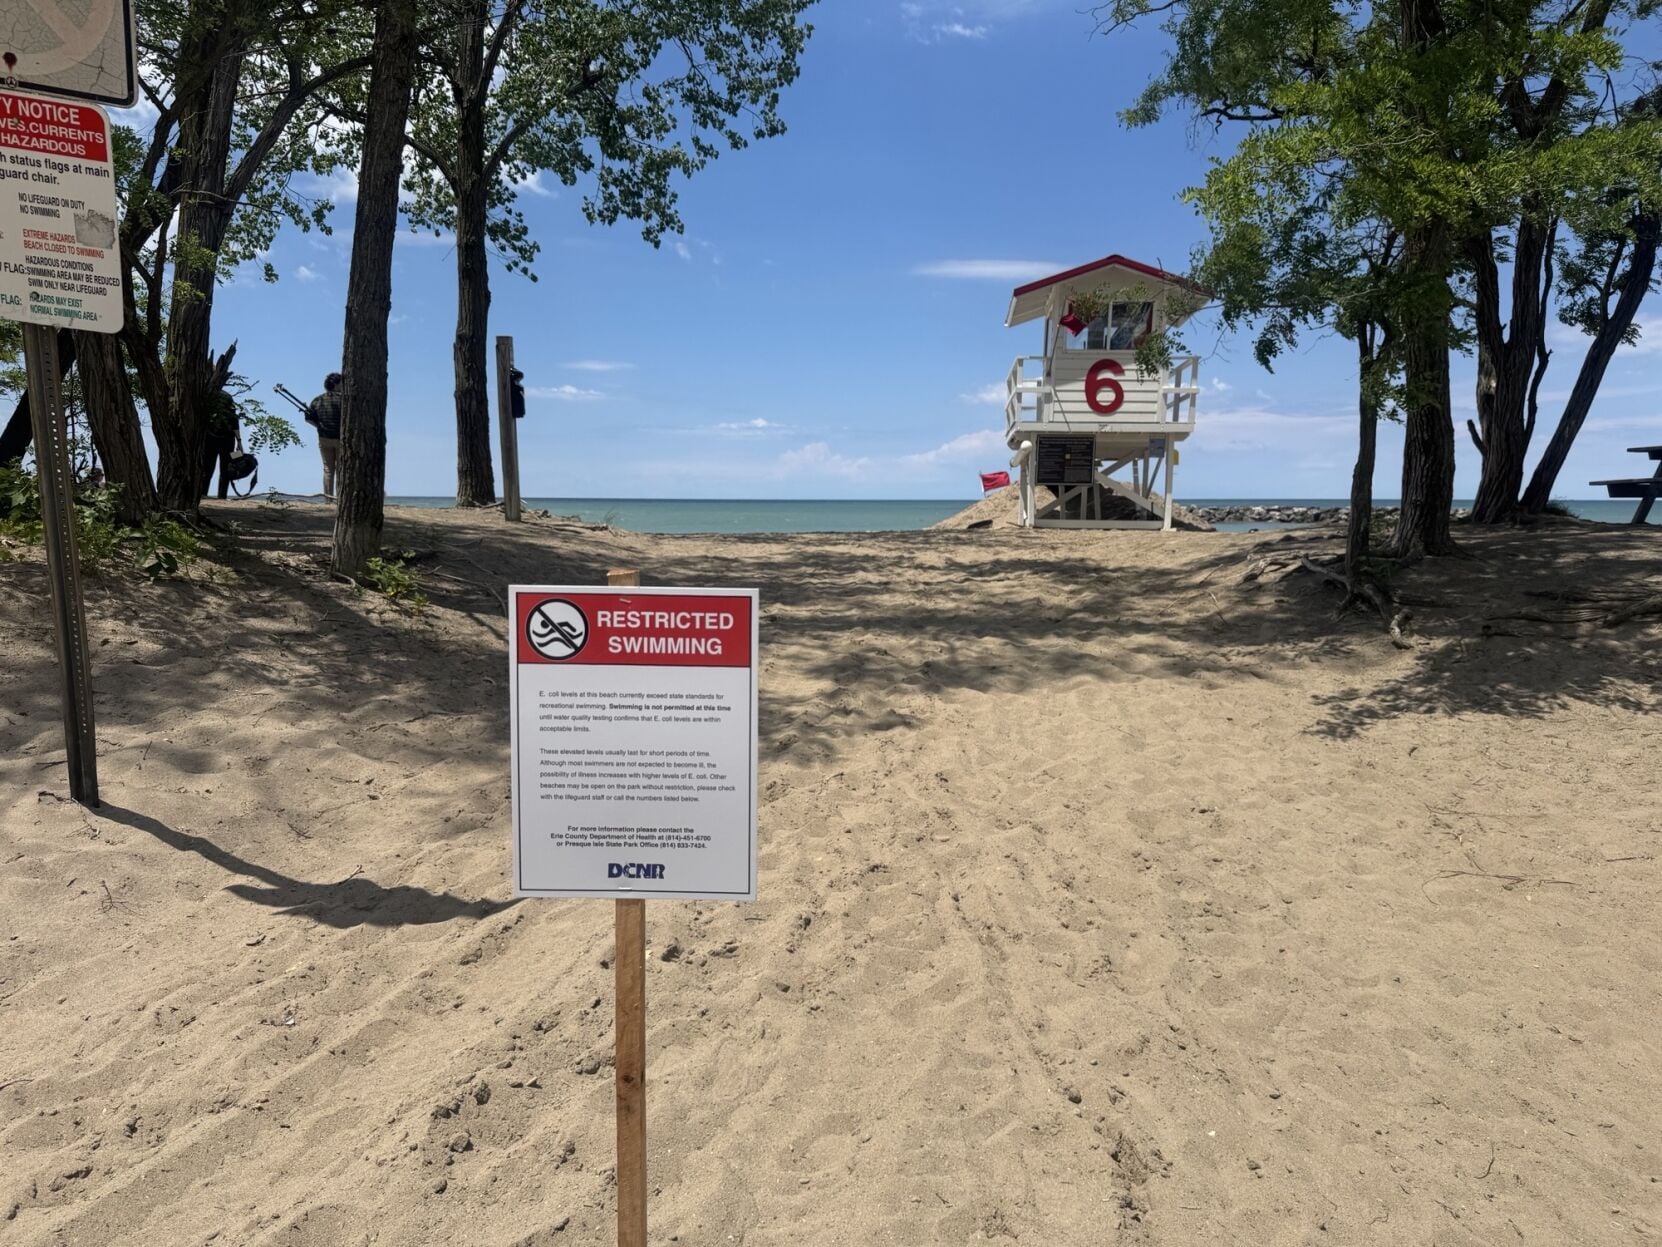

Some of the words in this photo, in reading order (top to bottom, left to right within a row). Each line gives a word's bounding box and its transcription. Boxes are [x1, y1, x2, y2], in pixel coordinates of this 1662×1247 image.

[0, 96, 12, 114] Y
[18, 100, 80, 125] NOTICE
[1, 132, 86, 155] HAZARDOUS
[10, 154, 42, 168] status
[44, 158, 70, 174] flags
[72, 164, 82, 174] at
[85, 166, 110, 178] main
[0, 168, 29, 180] guard
[32, 172, 60, 184] chair.
[18, 192, 27, 202] NO
[28, 194, 60, 206] LIFEGUARD
[60, 198, 70, 207] ON
[70, 200, 85, 210] DUTY
[20, 205, 29, 214] NO
[30, 206, 60, 218] SWIMMING
[23, 229, 49, 240] EXTREME
[50, 232, 76, 244] HAZARDS
[24, 240, 43, 250] BEACH
[44, 242, 67, 254] CLOSED
[68, 246, 75, 255] TO
[76, 247, 104, 259] SWIMMING
[25, 256, 60, 268] HAZARDOUS
[60, 260, 94, 272] CONDITIONS
[27, 266, 56, 278] SWIMMING
[57, 271, 72, 280] AREA
[73, 273, 84, 282] MAY
[85, 274, 92, 283] BE
[94, 276, 120, 286] REDUCED
[28, 278, 43, 287] SWIM
[44, 280, 59, 289] ONLY
[60, 282, 75, 292] NEAR
[76, 284, 107, 296] LIFEGUARD
[0, 294, 22, 305] FLAG:
[55, 297, 67, 305] MAY
[68, 298, 82, 308] EXIST
[30, 304, 53, 316] NORMAL
[54, 307, 81, 319] SWIMMING
[83, 311, 97, 321] AREA
[1084, 358, 1125, 414] 6
[597, 610, 734, 630] RESTRICTED
[608, 636, 722, 655] SWIMMING
[608, 863, 665, 879] DCNR
